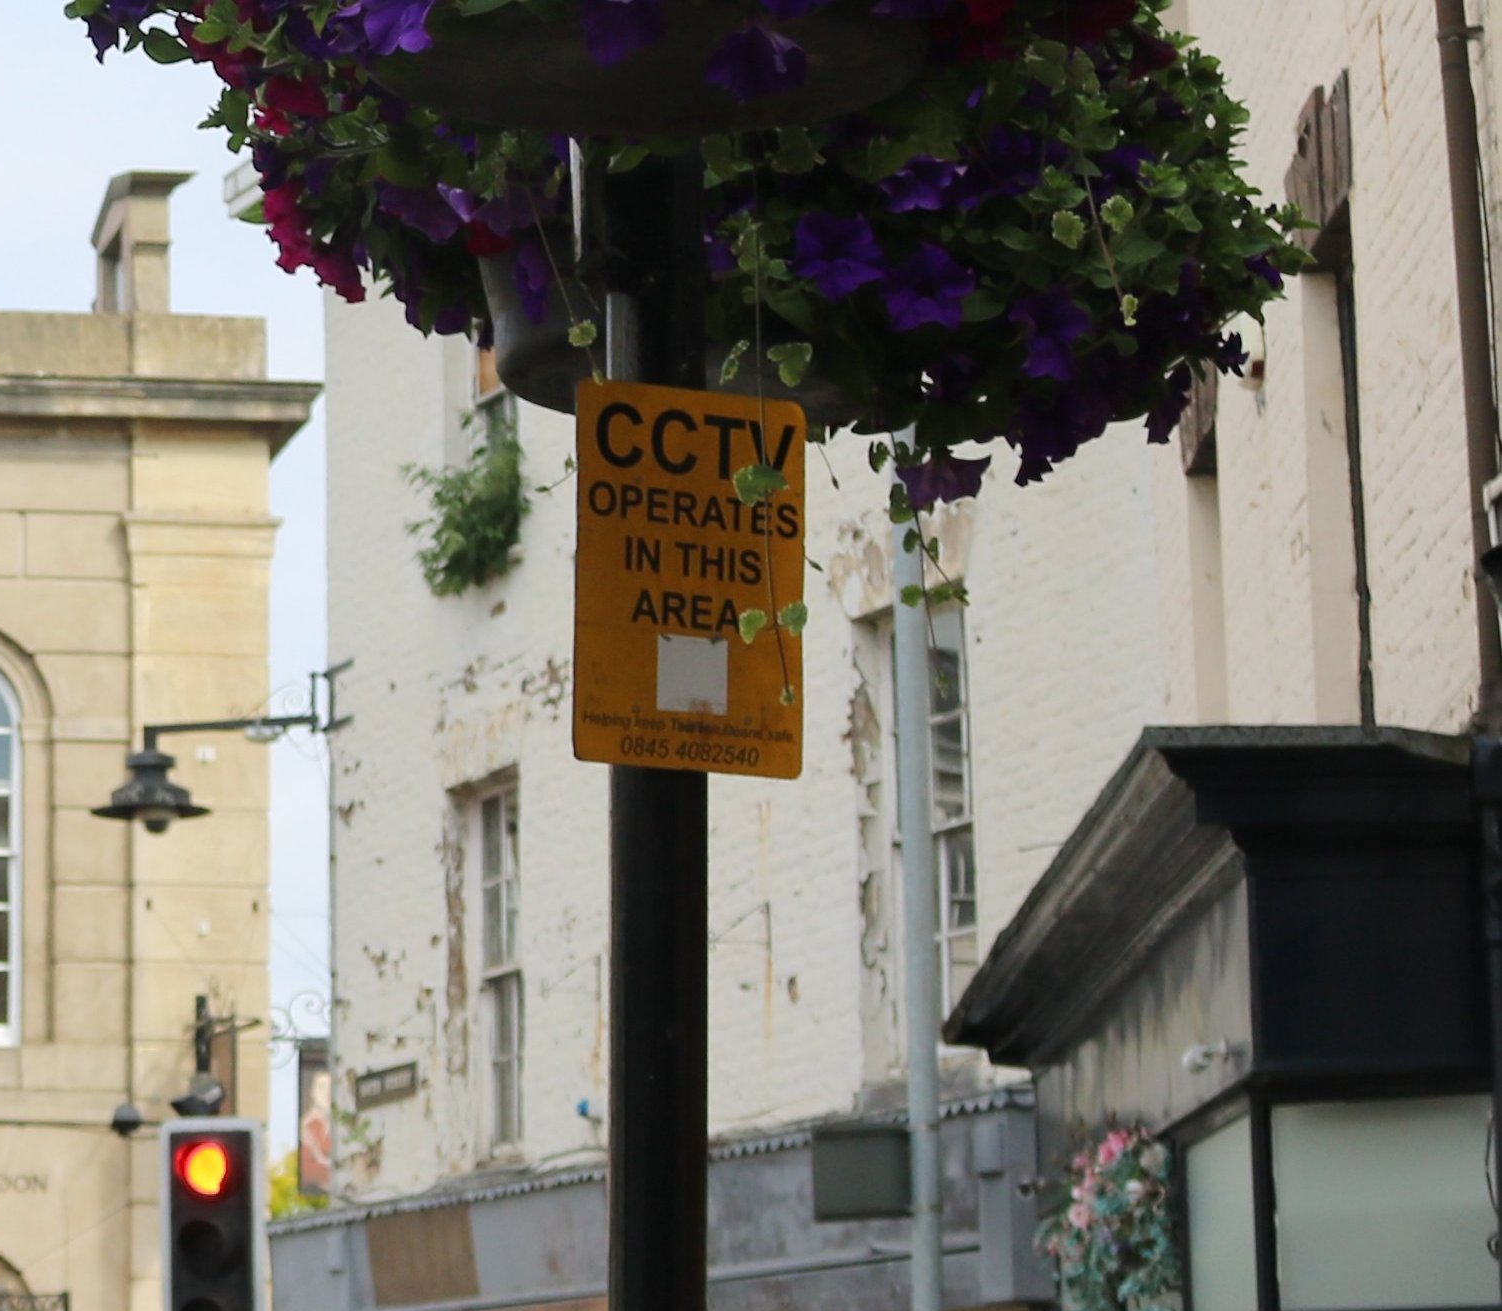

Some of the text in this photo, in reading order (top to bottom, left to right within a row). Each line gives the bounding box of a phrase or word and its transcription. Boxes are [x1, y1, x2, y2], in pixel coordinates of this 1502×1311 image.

[596, 402, 795, 482] CCTV
[588, 480, 800, 540] OPERATES
[624, 536, 763, 586] IN THIS
[631, 589, 741, 635] AREA
[620, 735, 760, 768] 0845 4082540
